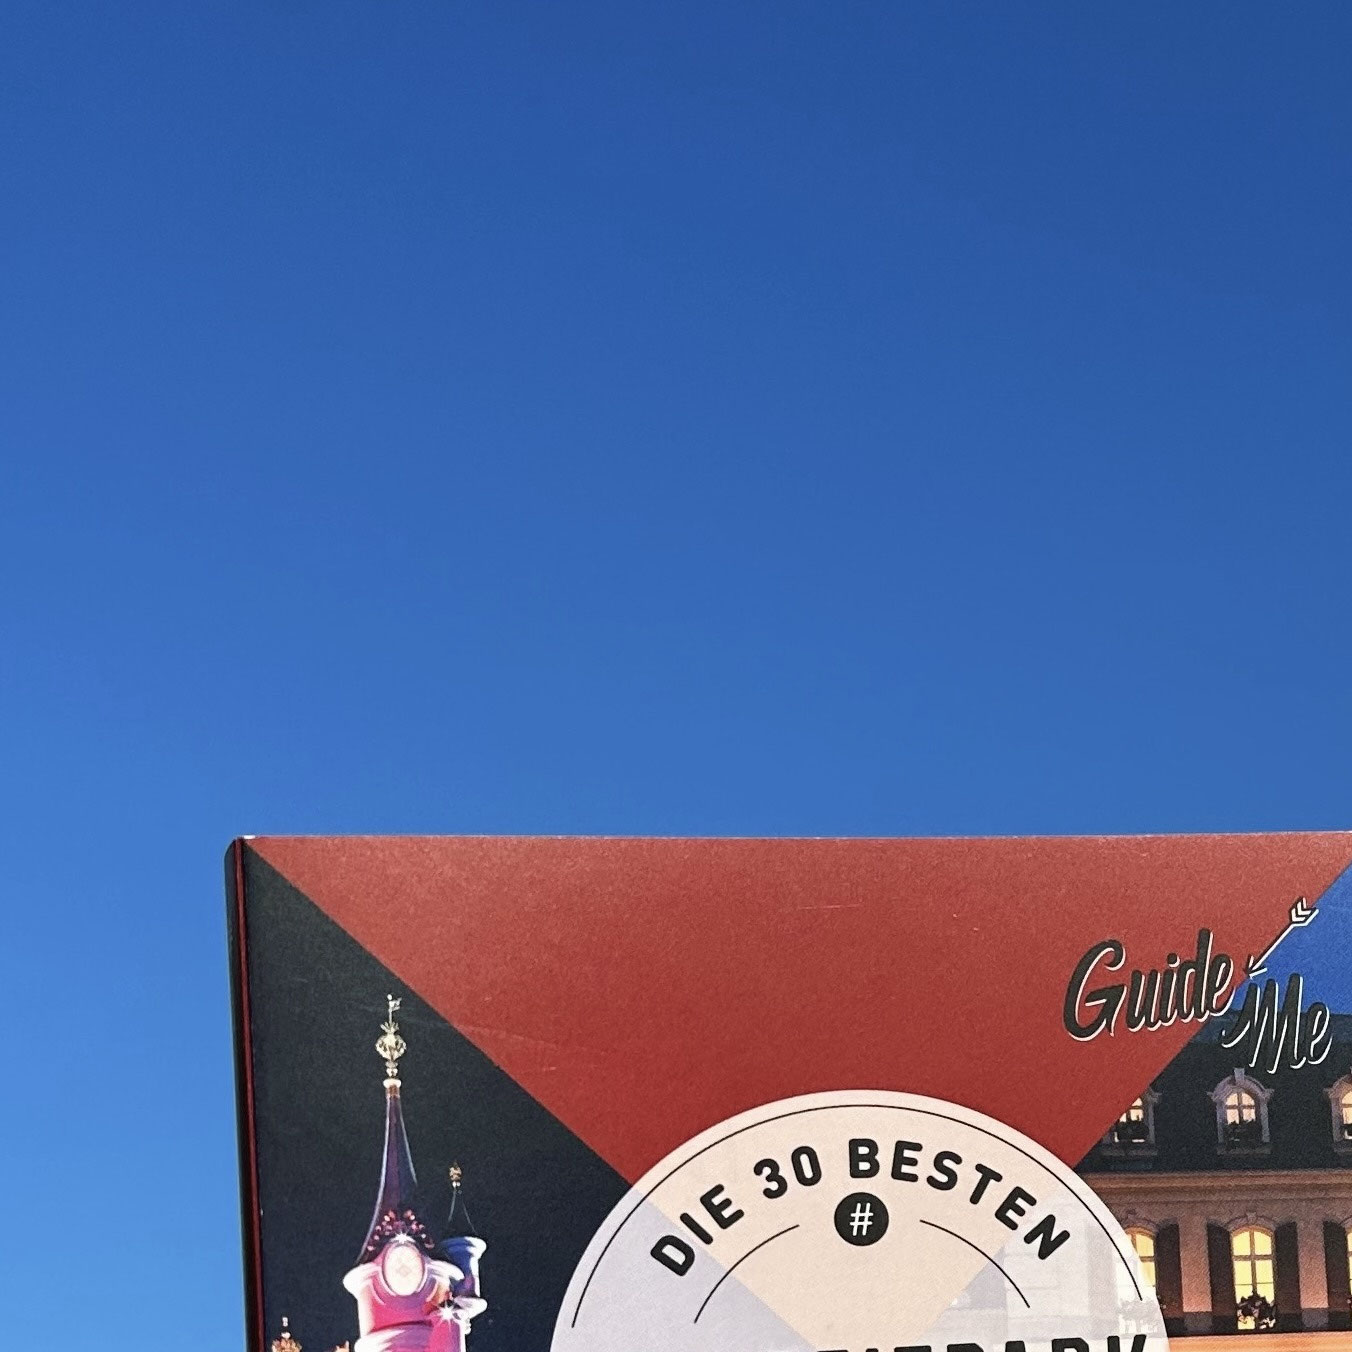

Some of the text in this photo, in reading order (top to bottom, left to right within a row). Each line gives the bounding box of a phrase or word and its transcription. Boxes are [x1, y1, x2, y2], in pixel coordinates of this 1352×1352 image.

[1062, 928, 1333, 1075] Guide Me
[650, 1138, 1071, 1277] DIE 30 BESTEN
[849, 1202, 875, 1236] #
